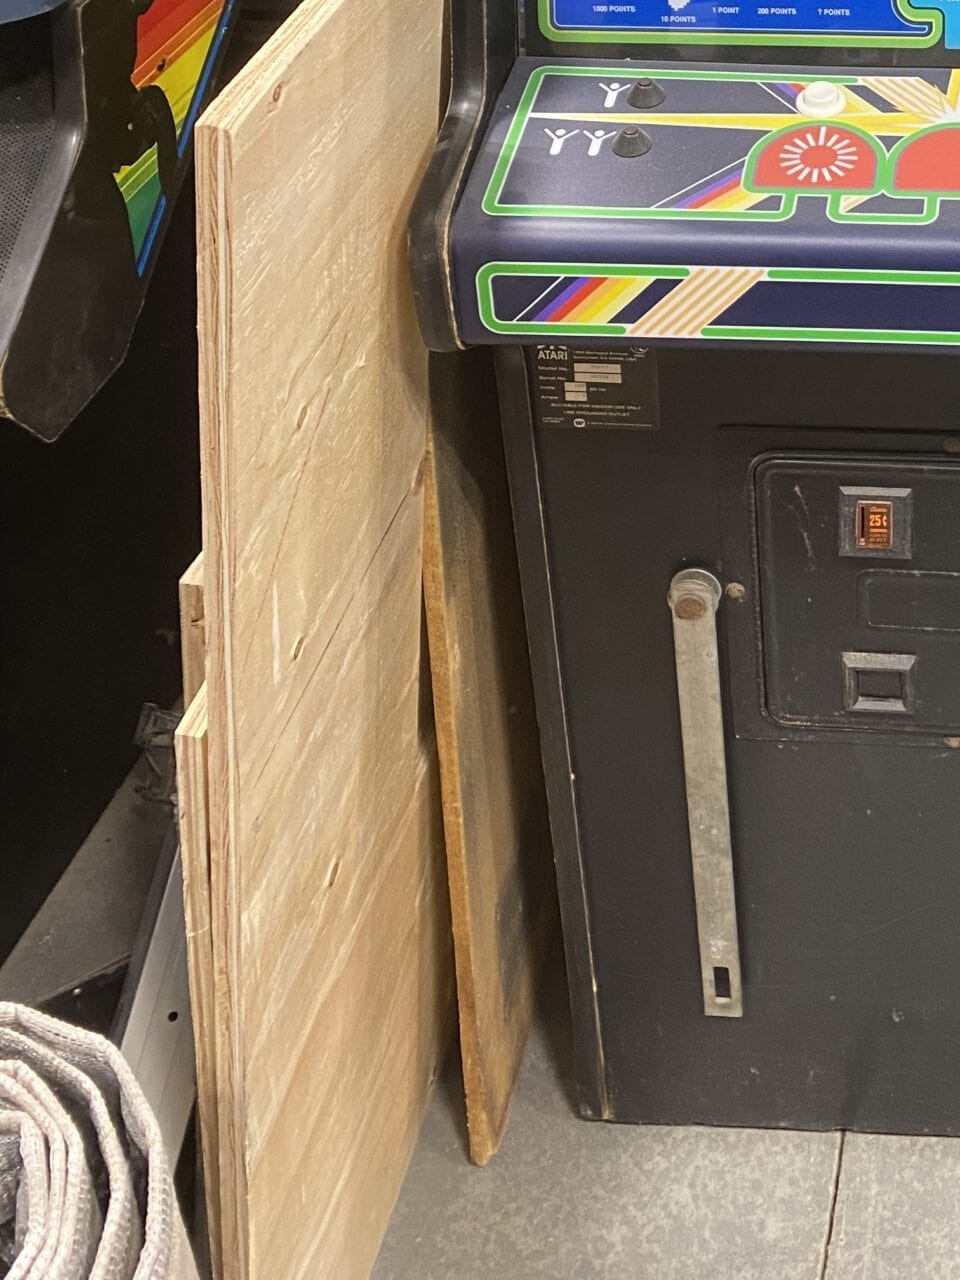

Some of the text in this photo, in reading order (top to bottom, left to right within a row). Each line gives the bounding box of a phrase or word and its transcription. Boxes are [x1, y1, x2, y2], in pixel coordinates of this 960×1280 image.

[592, 5, 636, 13] 1000 POINTS
[718, 6, 740, 14] POINT
[757, 7, 797, 15] 200 POINTS
[823, 8, 850, 16] POINTS
[660, 15, 697, 23] 10 POINTS
[538, 350, 568, 360] ATARI
